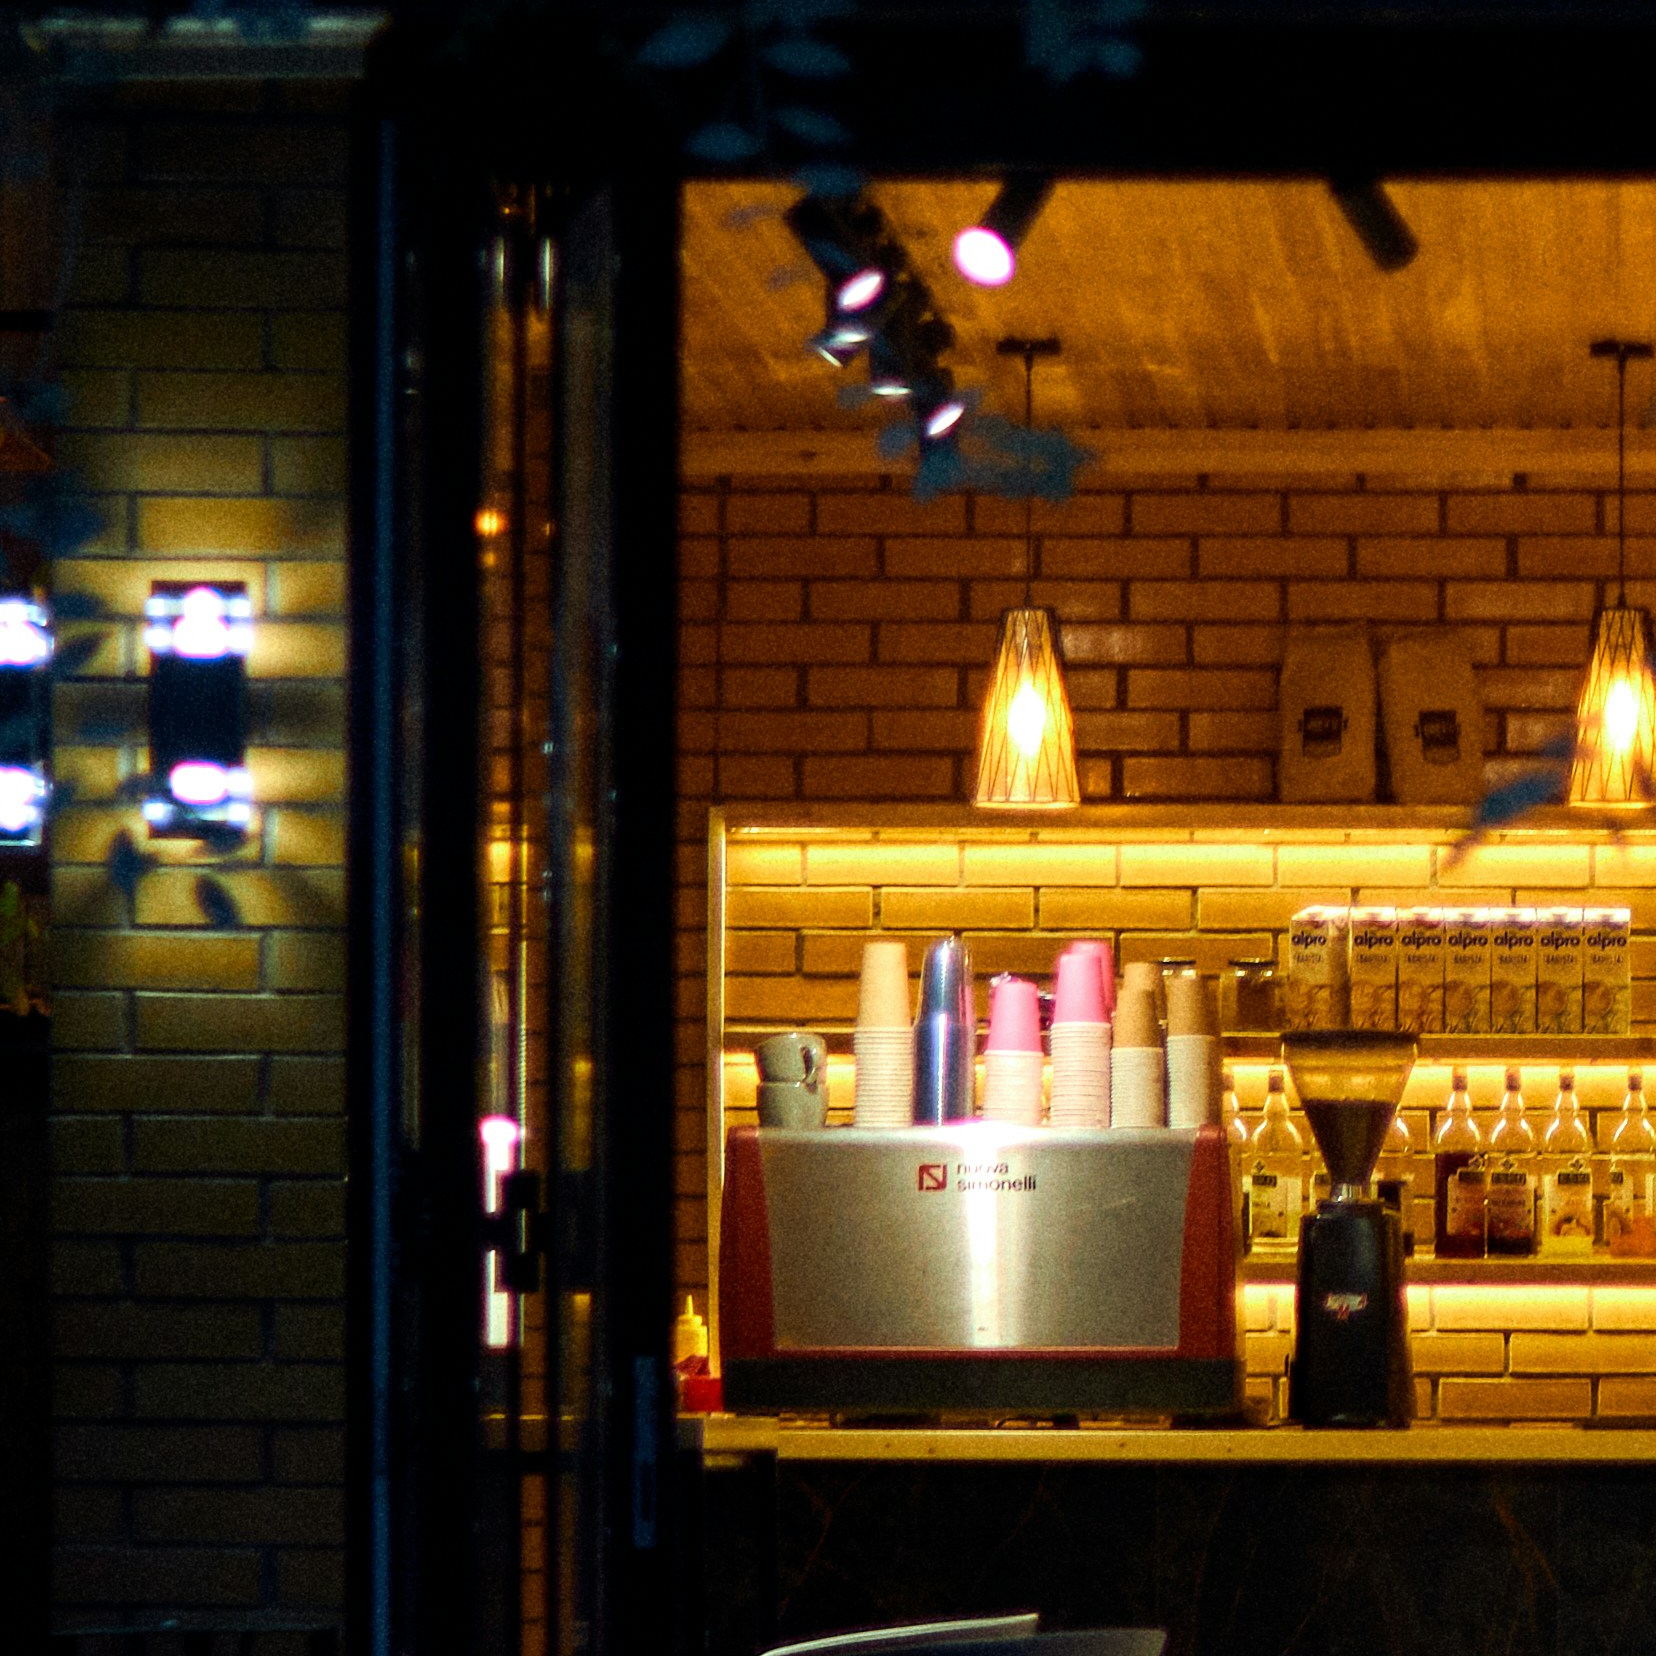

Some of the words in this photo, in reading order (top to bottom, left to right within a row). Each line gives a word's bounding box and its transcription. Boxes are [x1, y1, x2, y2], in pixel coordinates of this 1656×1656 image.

[1291, 930, 1327, 949] alpro
[1354, 930, 1394, 949] alpro
[1401, 930, 1442, 949] alpro
[1448, 931, 1488, 950] alpro
[1494, 931, 1534, 950] alpro
[1540, 931, 1580, 950] alpro
[1587, 931, 1627, 950] alpro
